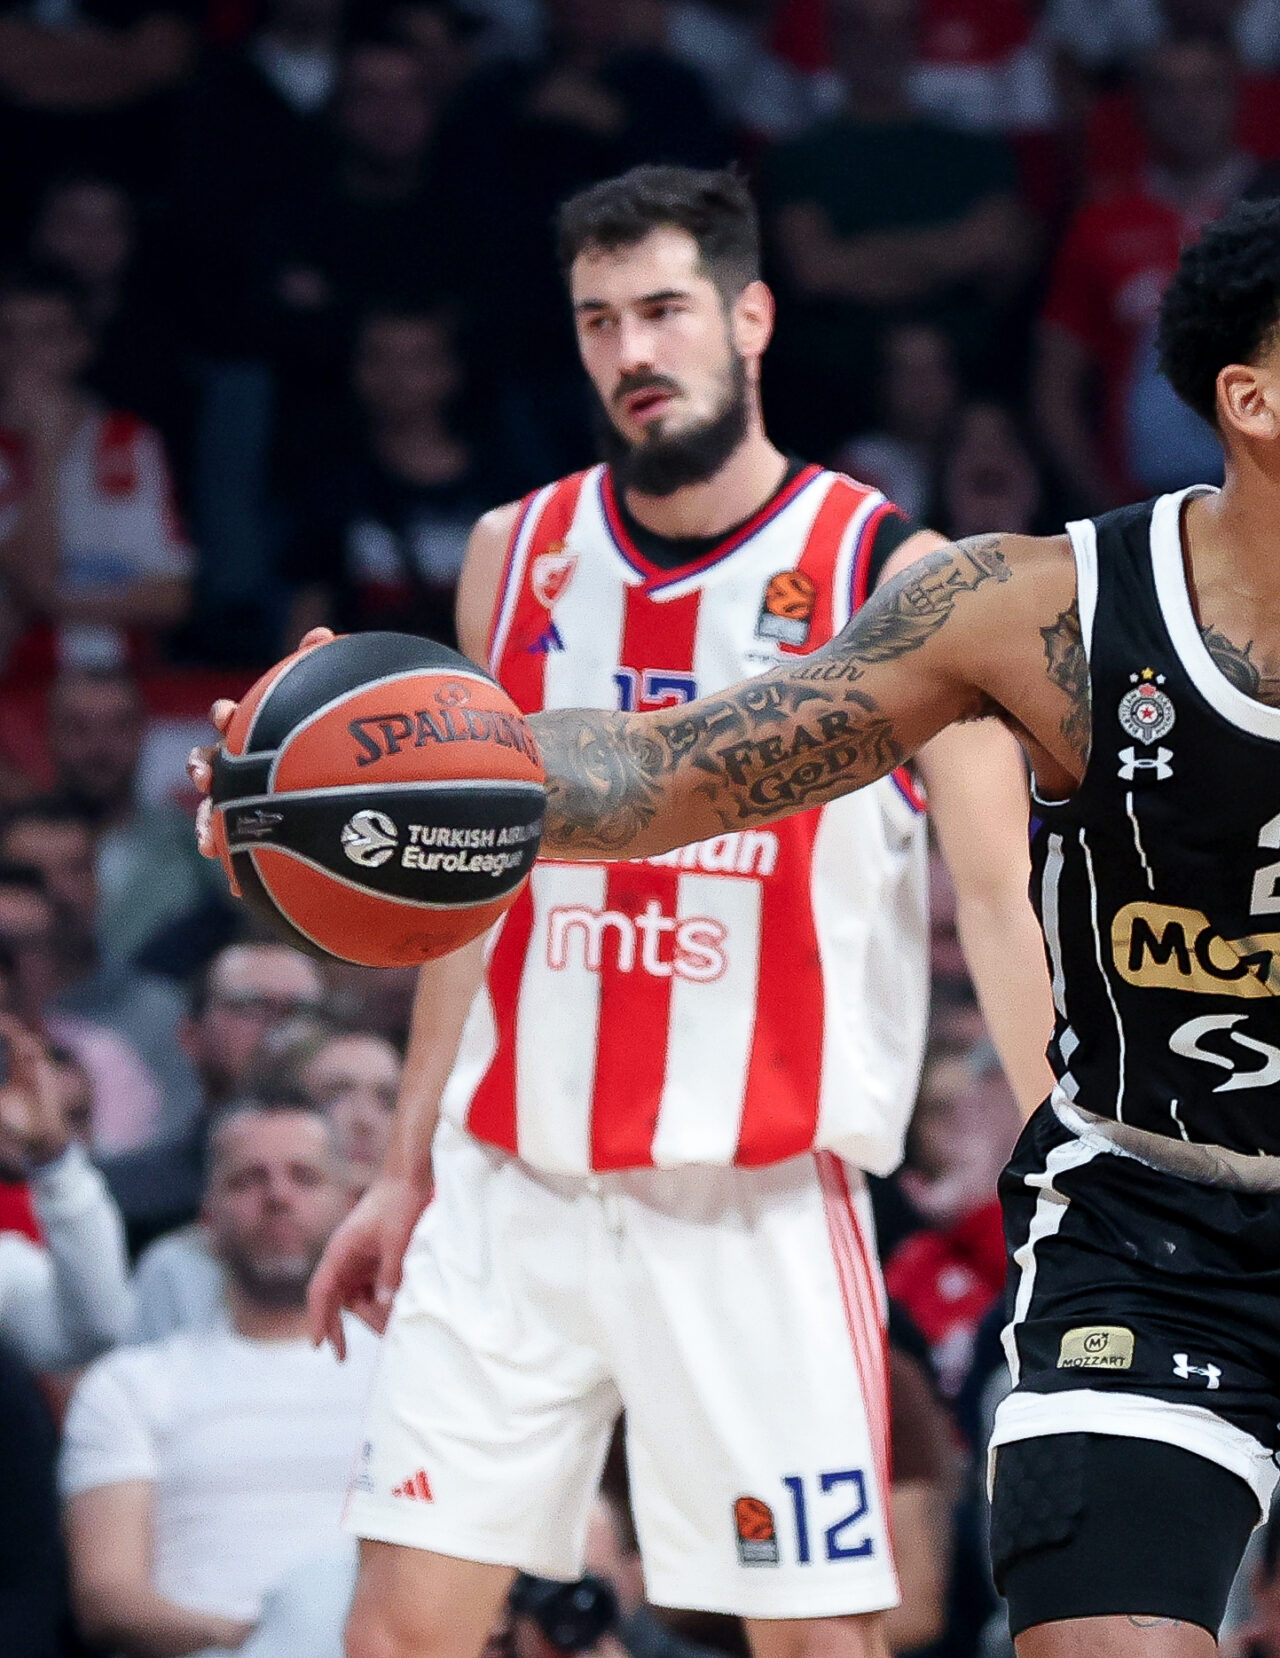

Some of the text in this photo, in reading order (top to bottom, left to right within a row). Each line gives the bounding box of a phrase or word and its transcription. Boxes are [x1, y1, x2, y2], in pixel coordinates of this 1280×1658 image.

[717, 711, 860, 785] FEAR
[408, 824, 495, 848] TURKISH
[547, 897, 728, 983] mts
[1062, 1356, 1125, 1367] MOZZART
[783, 1470, 873, 1562] 12
